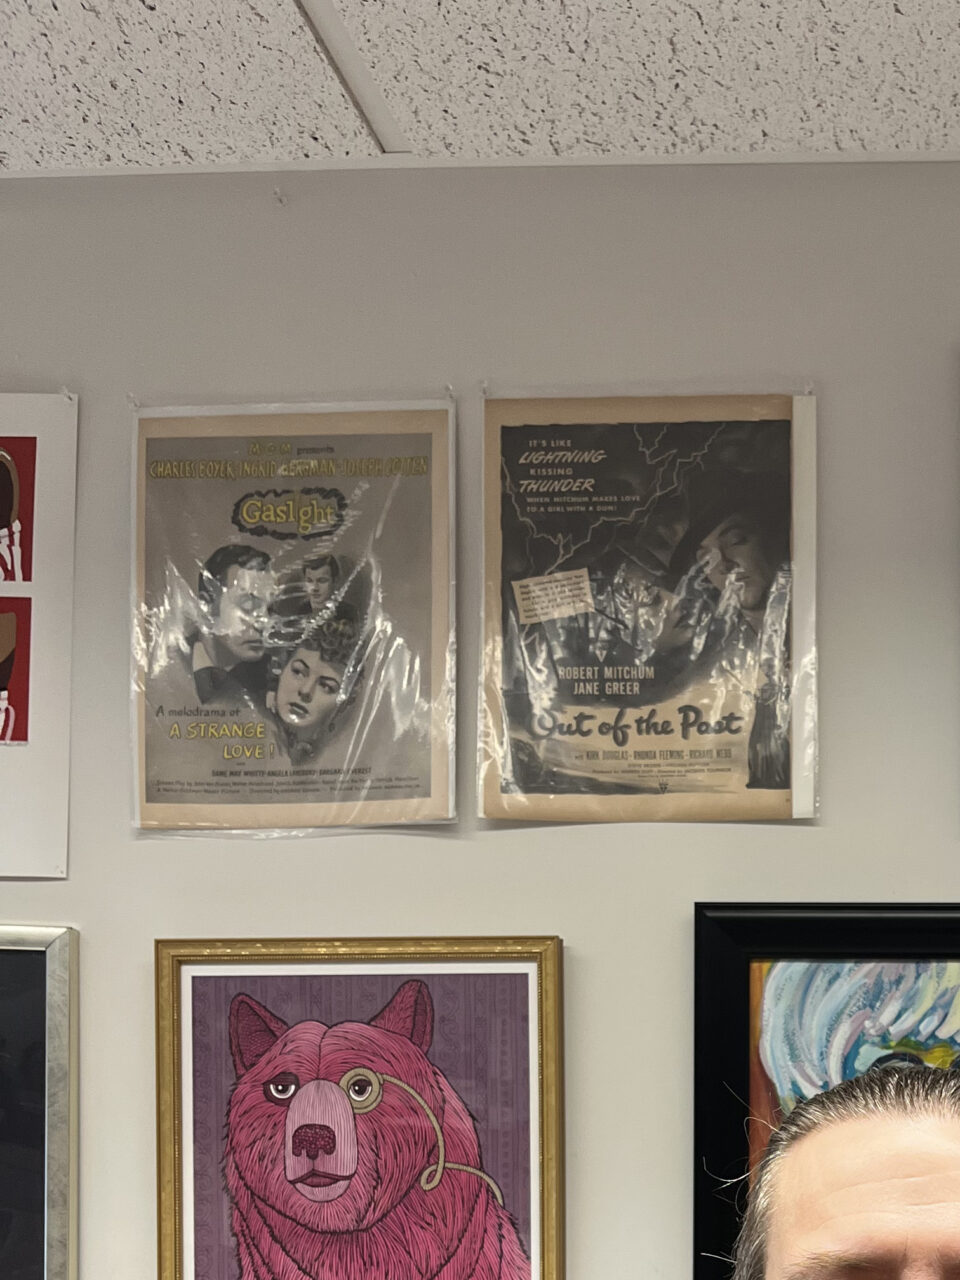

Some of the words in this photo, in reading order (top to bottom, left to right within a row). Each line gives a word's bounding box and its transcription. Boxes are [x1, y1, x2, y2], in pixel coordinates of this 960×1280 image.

[551, 439, 572, 448] LIKE
[518, 449, 608, 465] LIGHTNING
[150, 459, 197, 480] CHARLES
[529, 467, 574, 476] KISSING
[518, 477, 596, 493] THUNDER
[242, 499, 335, 534] Gaslght
[558, 666, 600, 680] ROBERT
[603, 666, 655, 680] MITCHUM
[573, 682, 600, 695] JANE
[605, 682, 640, 695] GREER
[155, 705, 165, 717] A
[168, 705, 226, 717] melodrama
[169, 722, 181, 739] A
[186, 722, 266, 739] STRANGE
[530, 709, 597, 740] Out
[598, 706, 632, 747] of
[634, 708, 675, 736] the
[677, 704, 745, 741] Past
